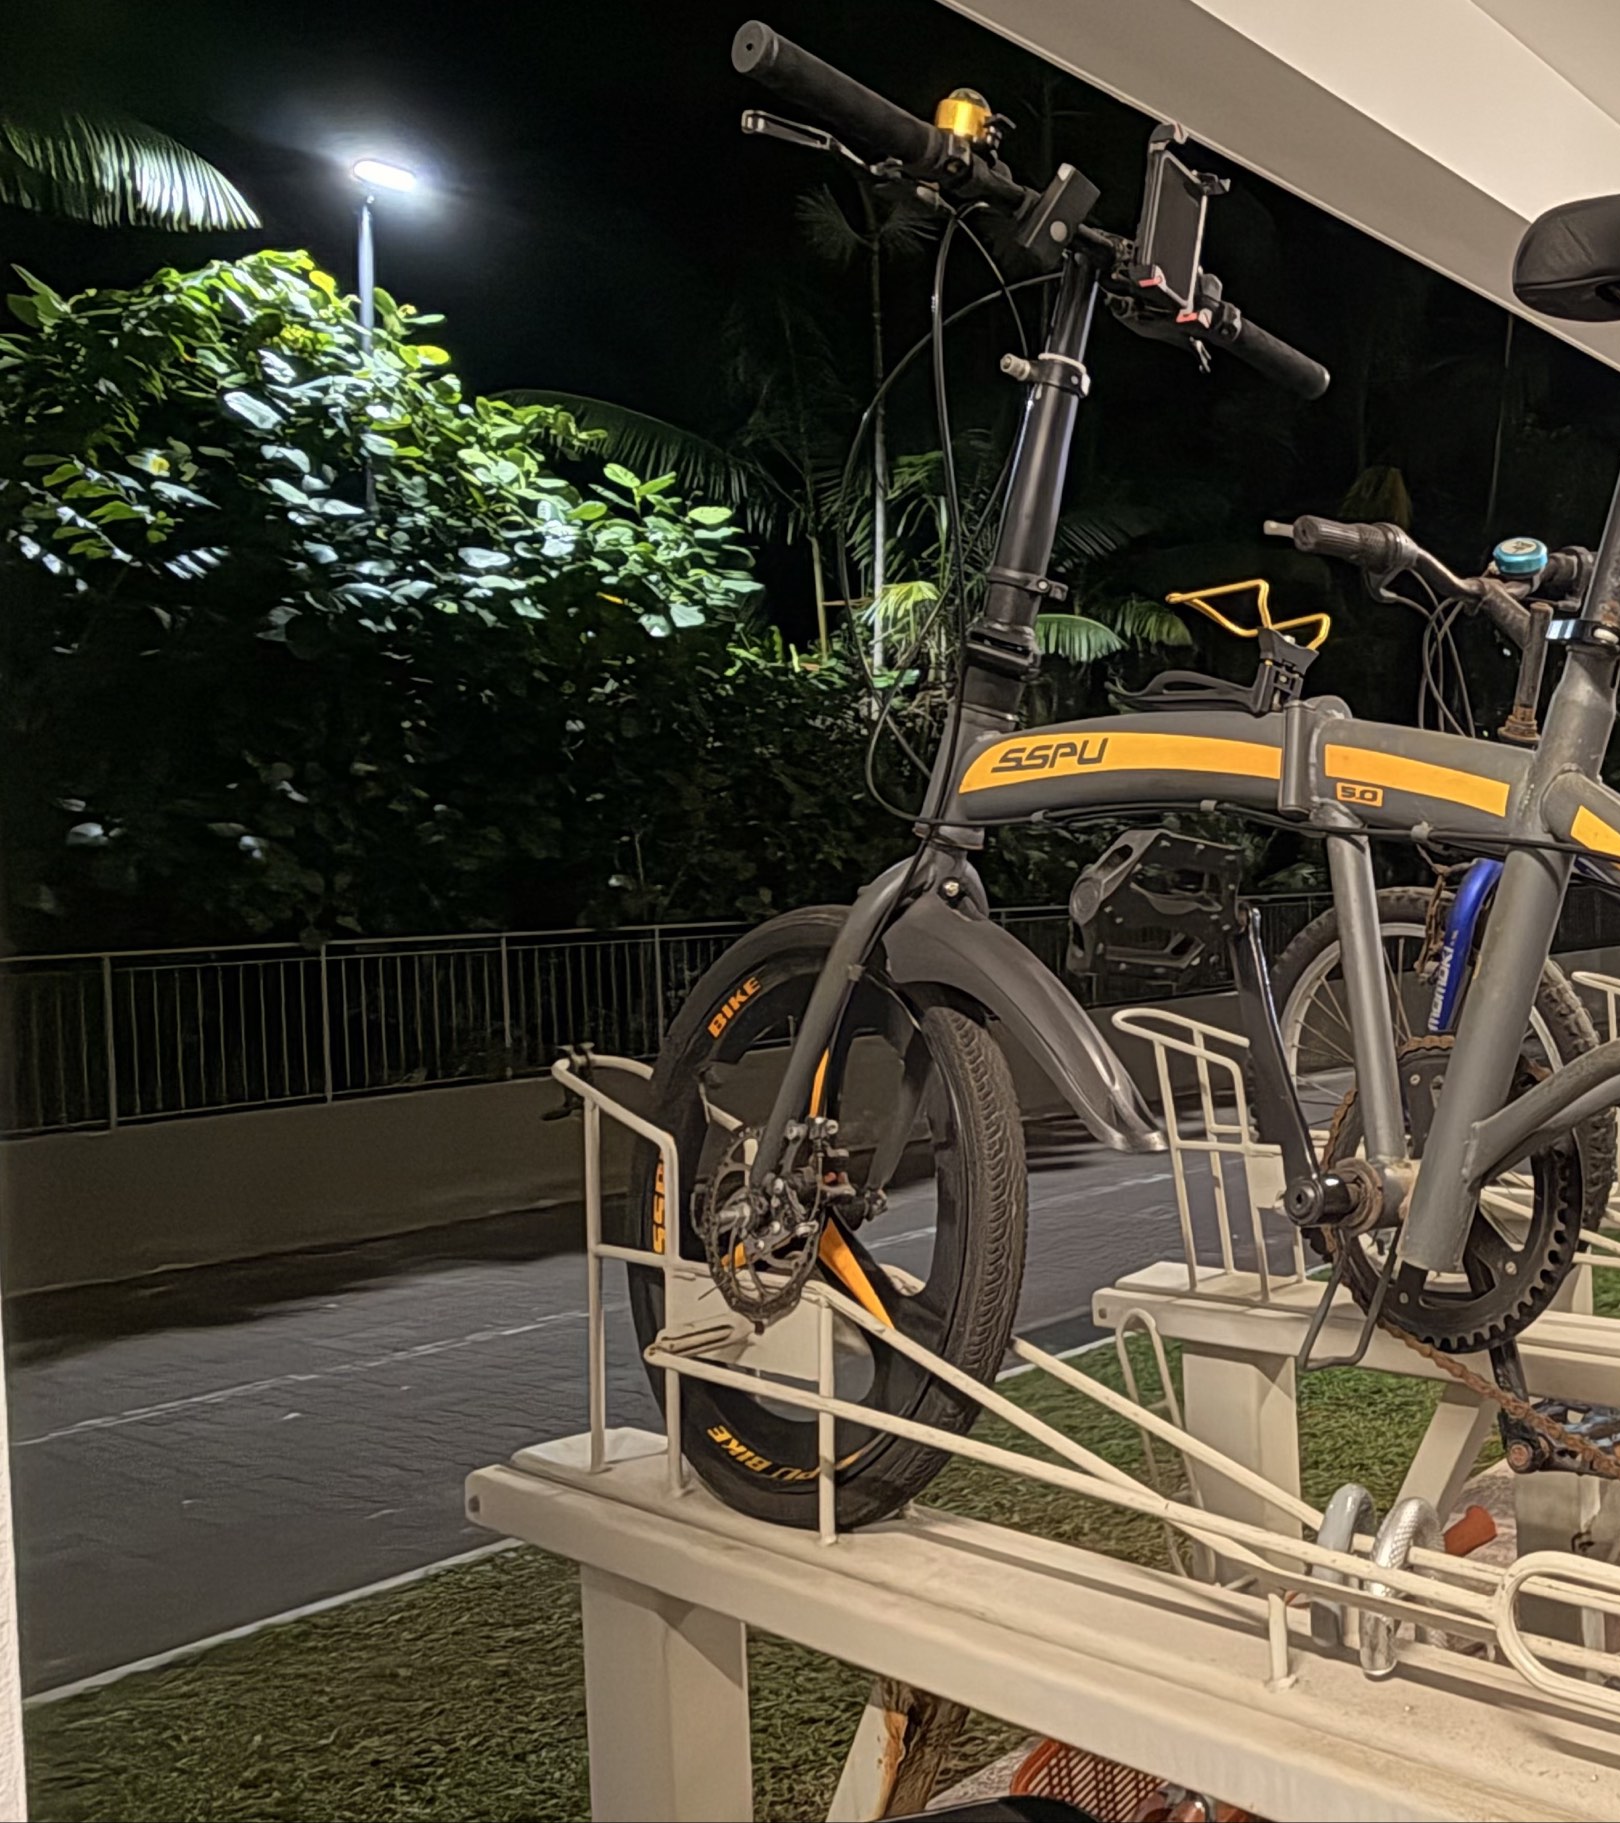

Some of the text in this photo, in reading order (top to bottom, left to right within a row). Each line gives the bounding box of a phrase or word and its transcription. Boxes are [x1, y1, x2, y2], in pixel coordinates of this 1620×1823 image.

[991, 737, 1109, 773] SSPU
[707, 976, 762, 1038] BIKE
[707, 1425, 772, 1472] BIKE
